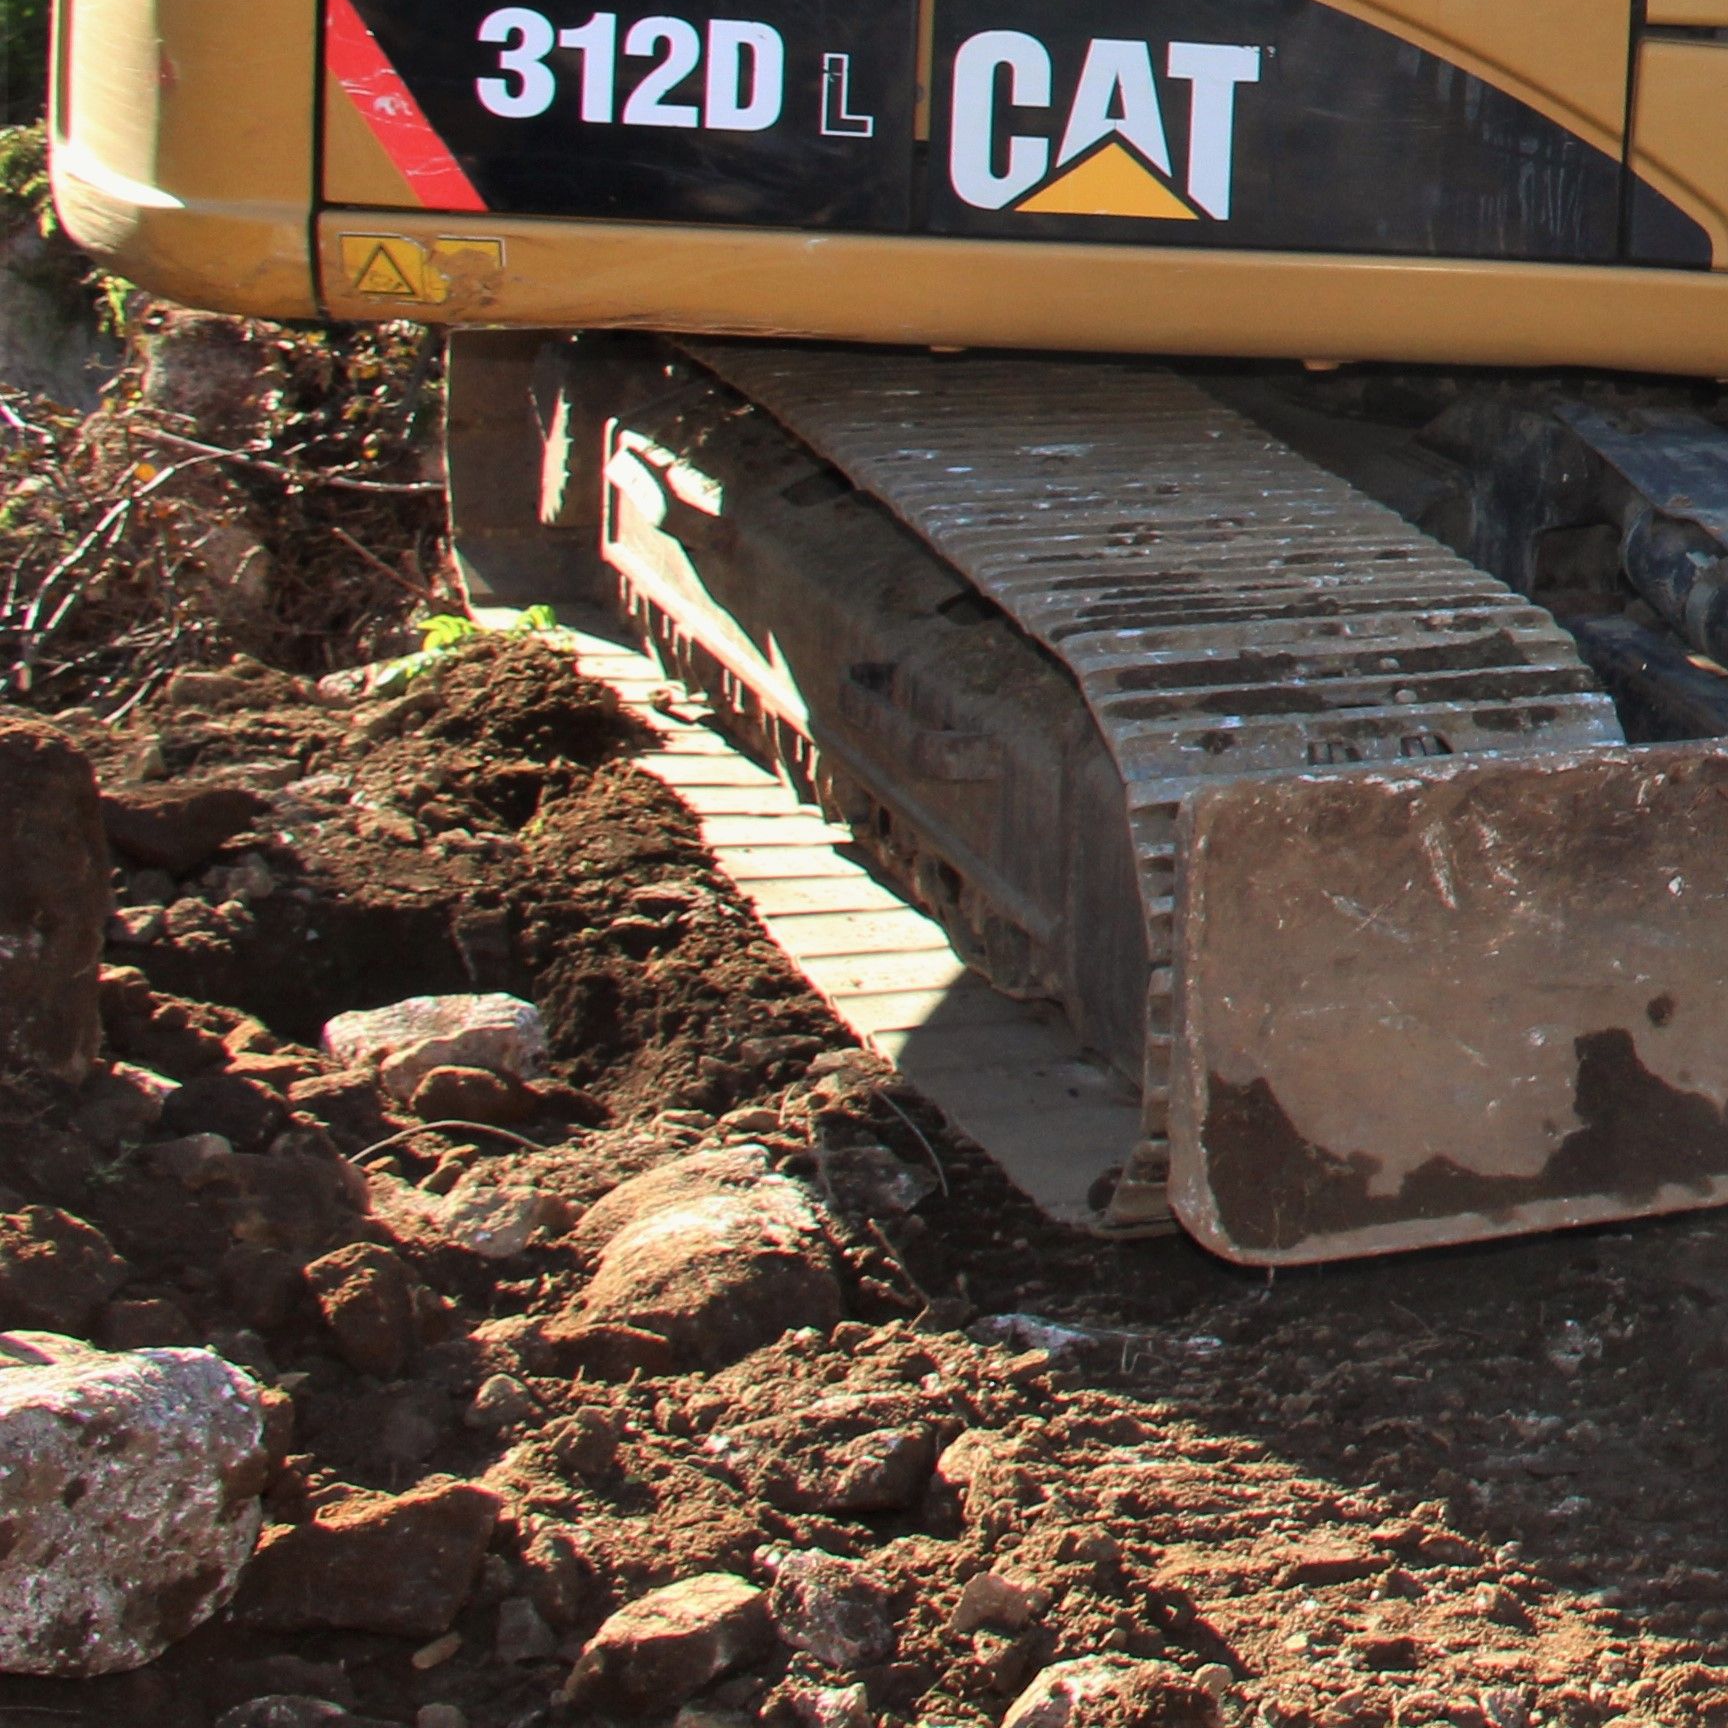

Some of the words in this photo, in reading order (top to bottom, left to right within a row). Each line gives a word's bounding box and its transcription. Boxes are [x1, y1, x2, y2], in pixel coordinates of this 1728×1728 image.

[475, 6, 784, 132] 312D
[820, 52, 874, 138] L
[950, 29, 1261, 221] CAT
